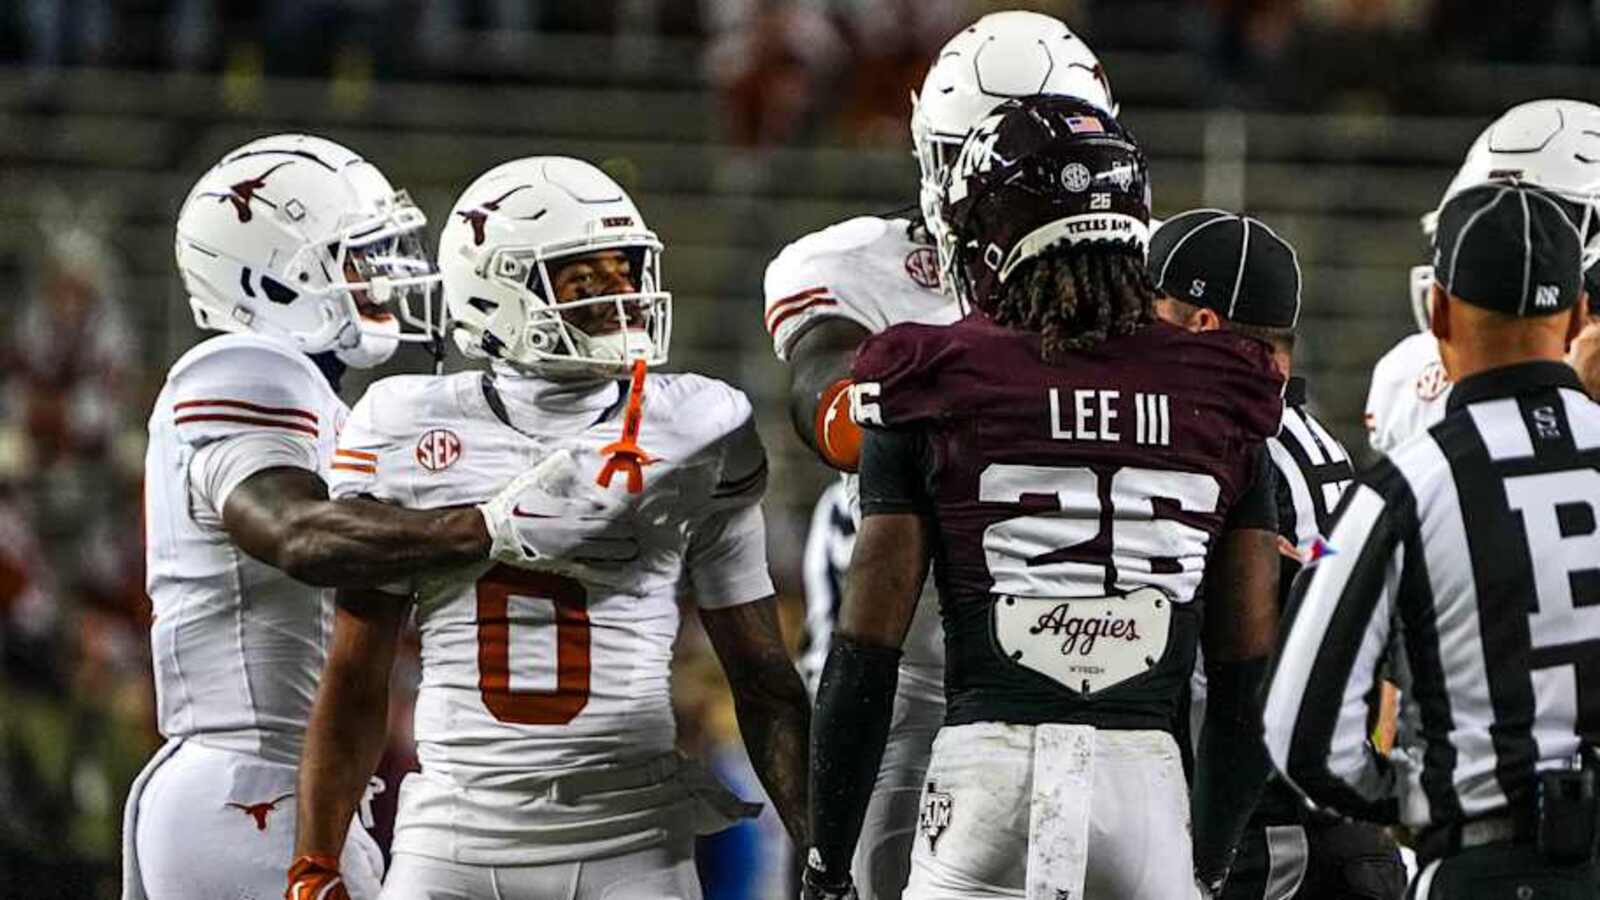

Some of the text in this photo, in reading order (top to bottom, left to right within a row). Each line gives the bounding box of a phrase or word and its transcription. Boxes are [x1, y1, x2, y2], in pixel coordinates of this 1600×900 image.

[1061, 163, 1091, 192] SEC
[1090, 193, 1111, 209] 26
[1066, 218, 1107, 234] TEXAS
[848, 381, 884, 425] 6
[1049, 388, 1170, 445] LEE III
[417, 430, 461, 470] SEC
[979, 463, 1220, 604] 26
[1503, 468, 1600, 648] B
[477, 562, 591, 725] 0
[1029, 603, 1141, 655] Aggies
